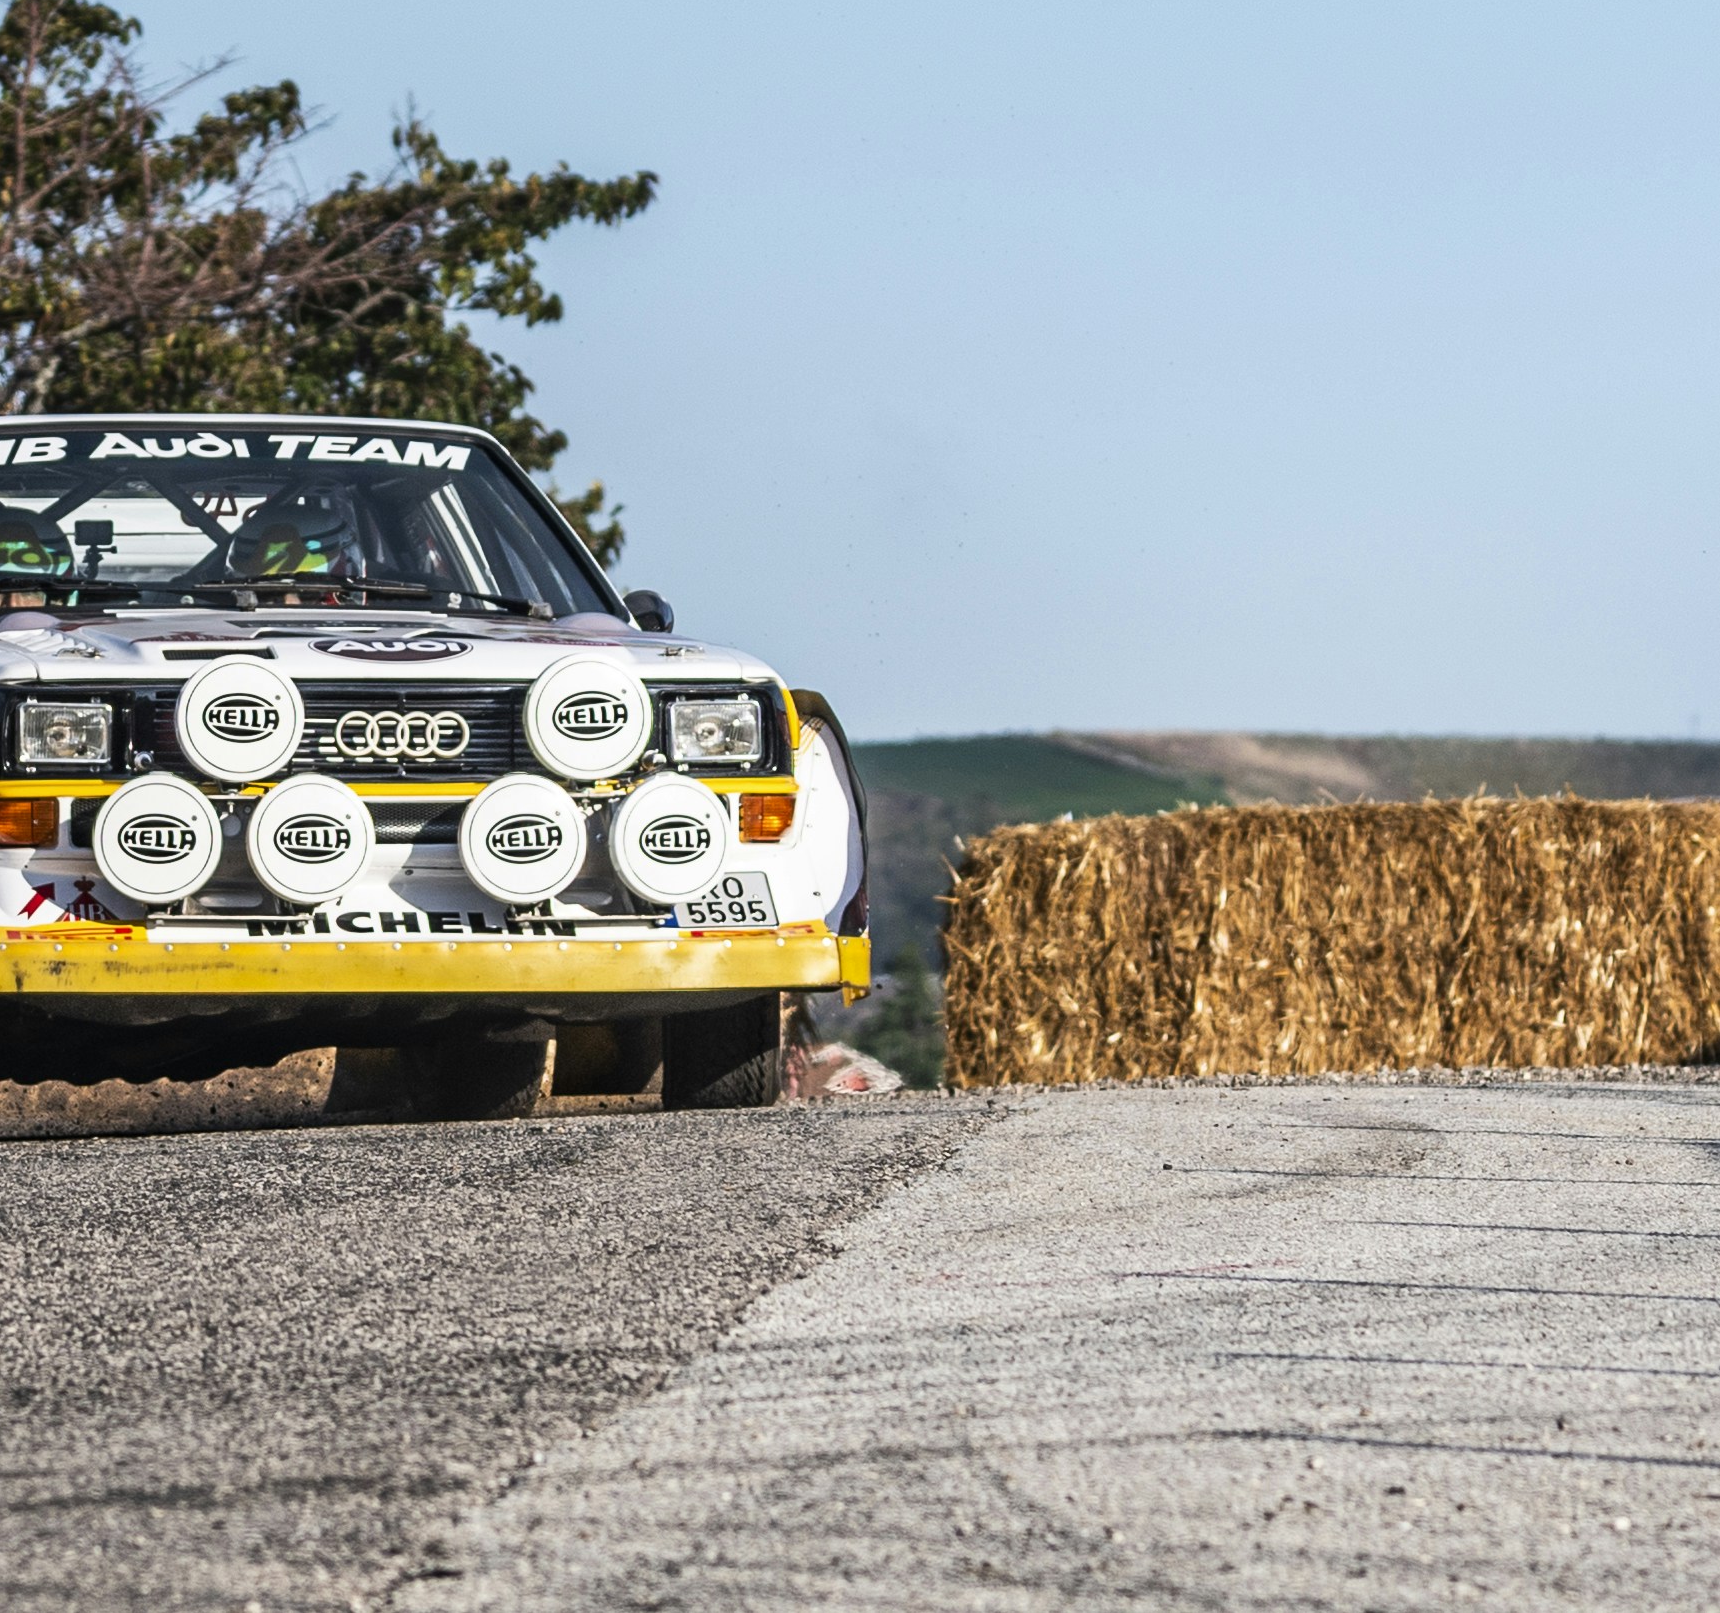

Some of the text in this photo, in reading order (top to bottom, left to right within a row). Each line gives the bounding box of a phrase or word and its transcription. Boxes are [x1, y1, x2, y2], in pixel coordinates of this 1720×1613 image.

[267, 434, 471, 471] TEAM
[208, 709, 280, 730] HELLA
[558, 703, 629, 725] HELLA
[123, 829, 197, 851] HELLA
[279, 828, 351, 850] HELLA
[491, 825, 563, 848] HELLA
[644, 828, 711, 849] HELLA
[67, 903, 106, 922] HB
[687, 900, 767, 924] 5595
